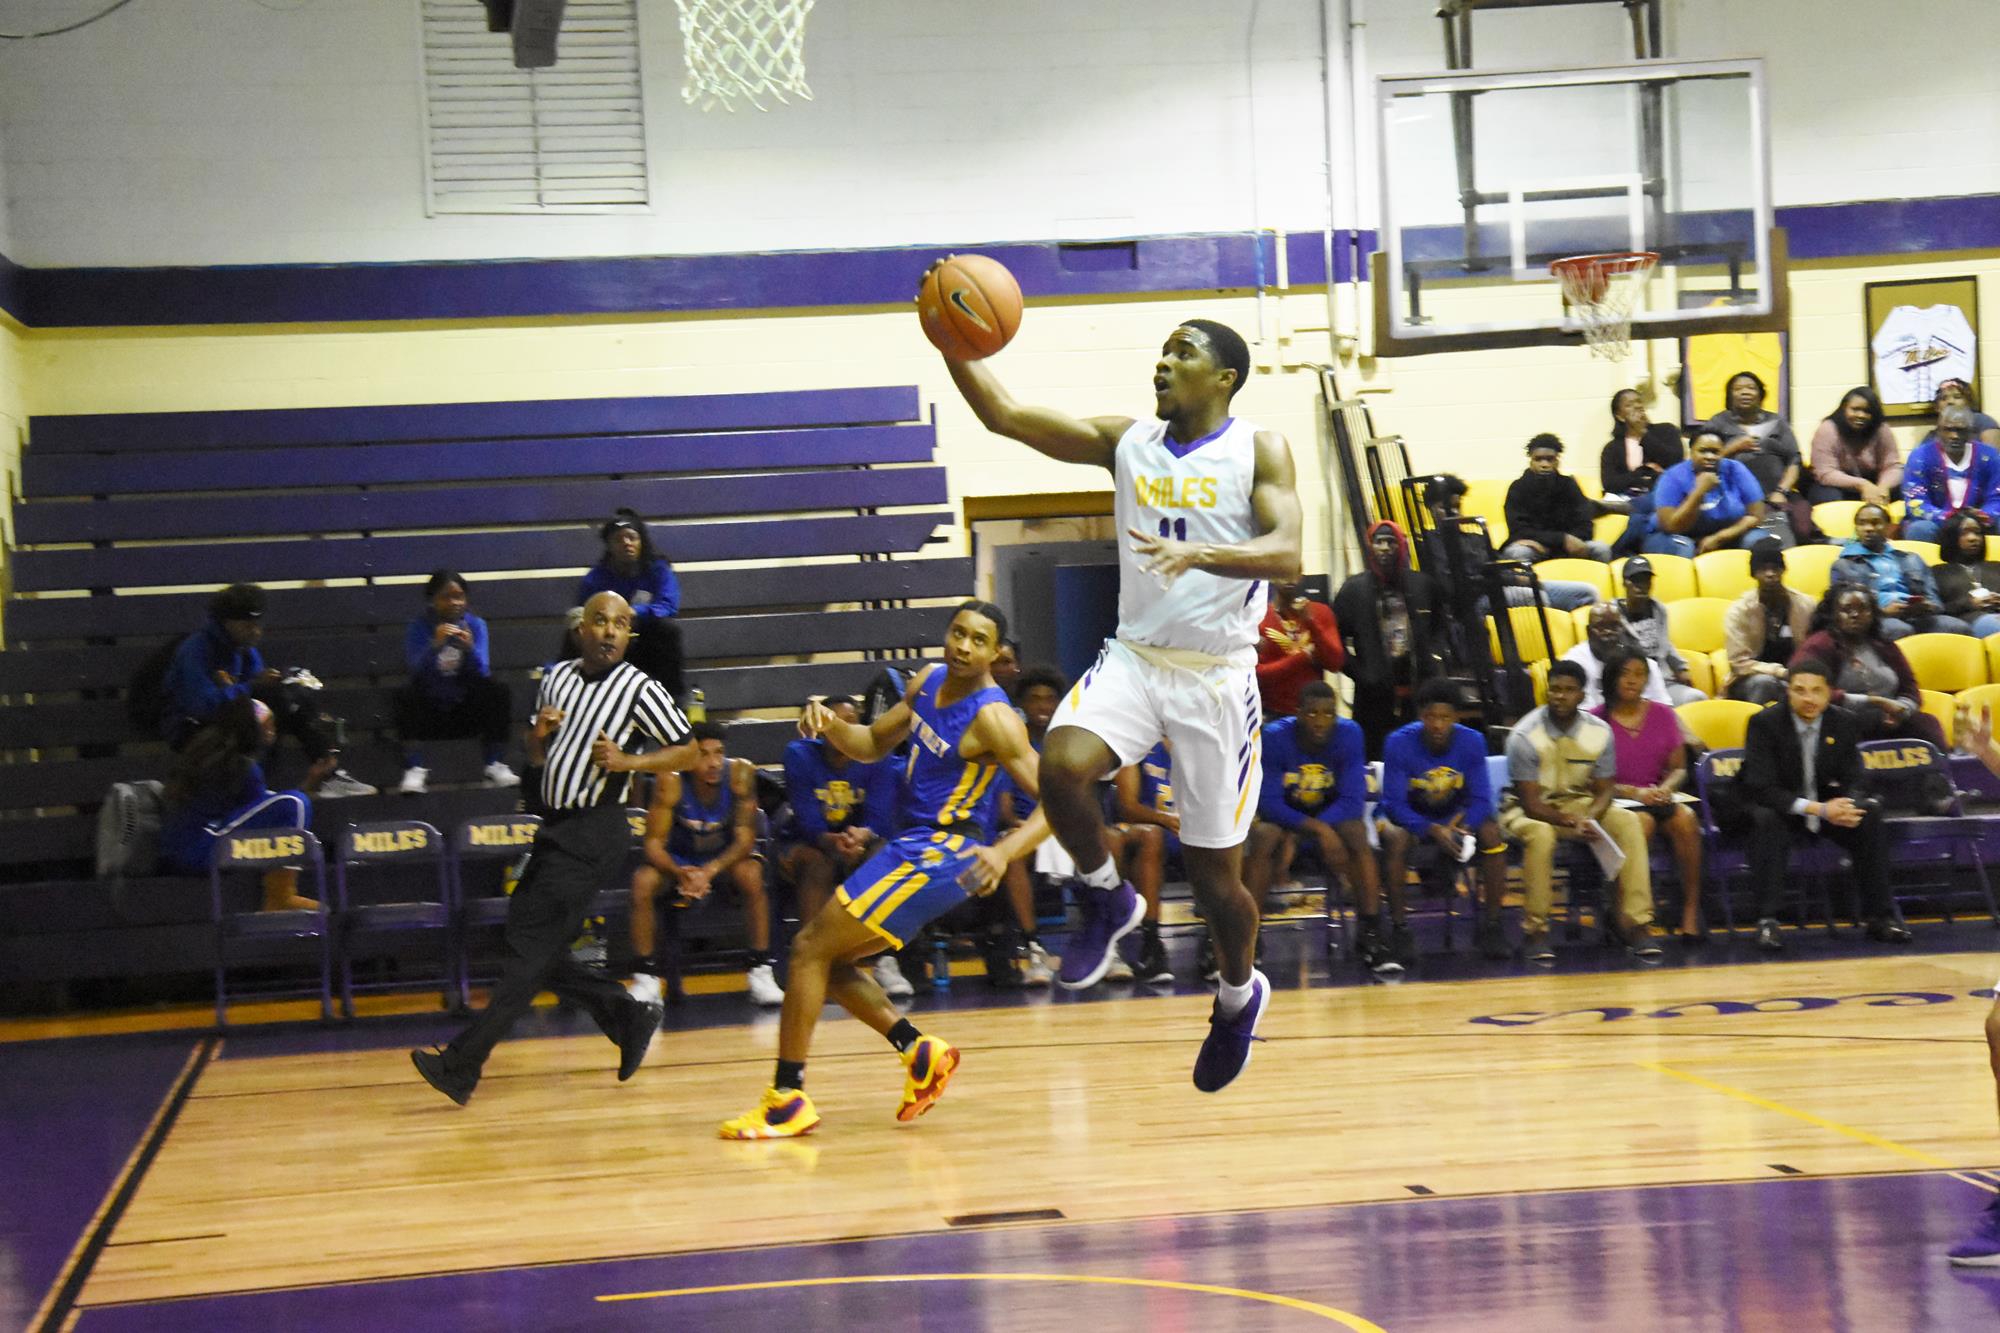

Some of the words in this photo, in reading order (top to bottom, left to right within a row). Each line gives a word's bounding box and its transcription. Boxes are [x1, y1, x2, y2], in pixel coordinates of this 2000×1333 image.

[1135, 475, 1217, 508] MILES
[1861, 746, 1933, 770] MILES
[231, 835, 305, 860] MILES
[353, 829, 428, 853] MILES
